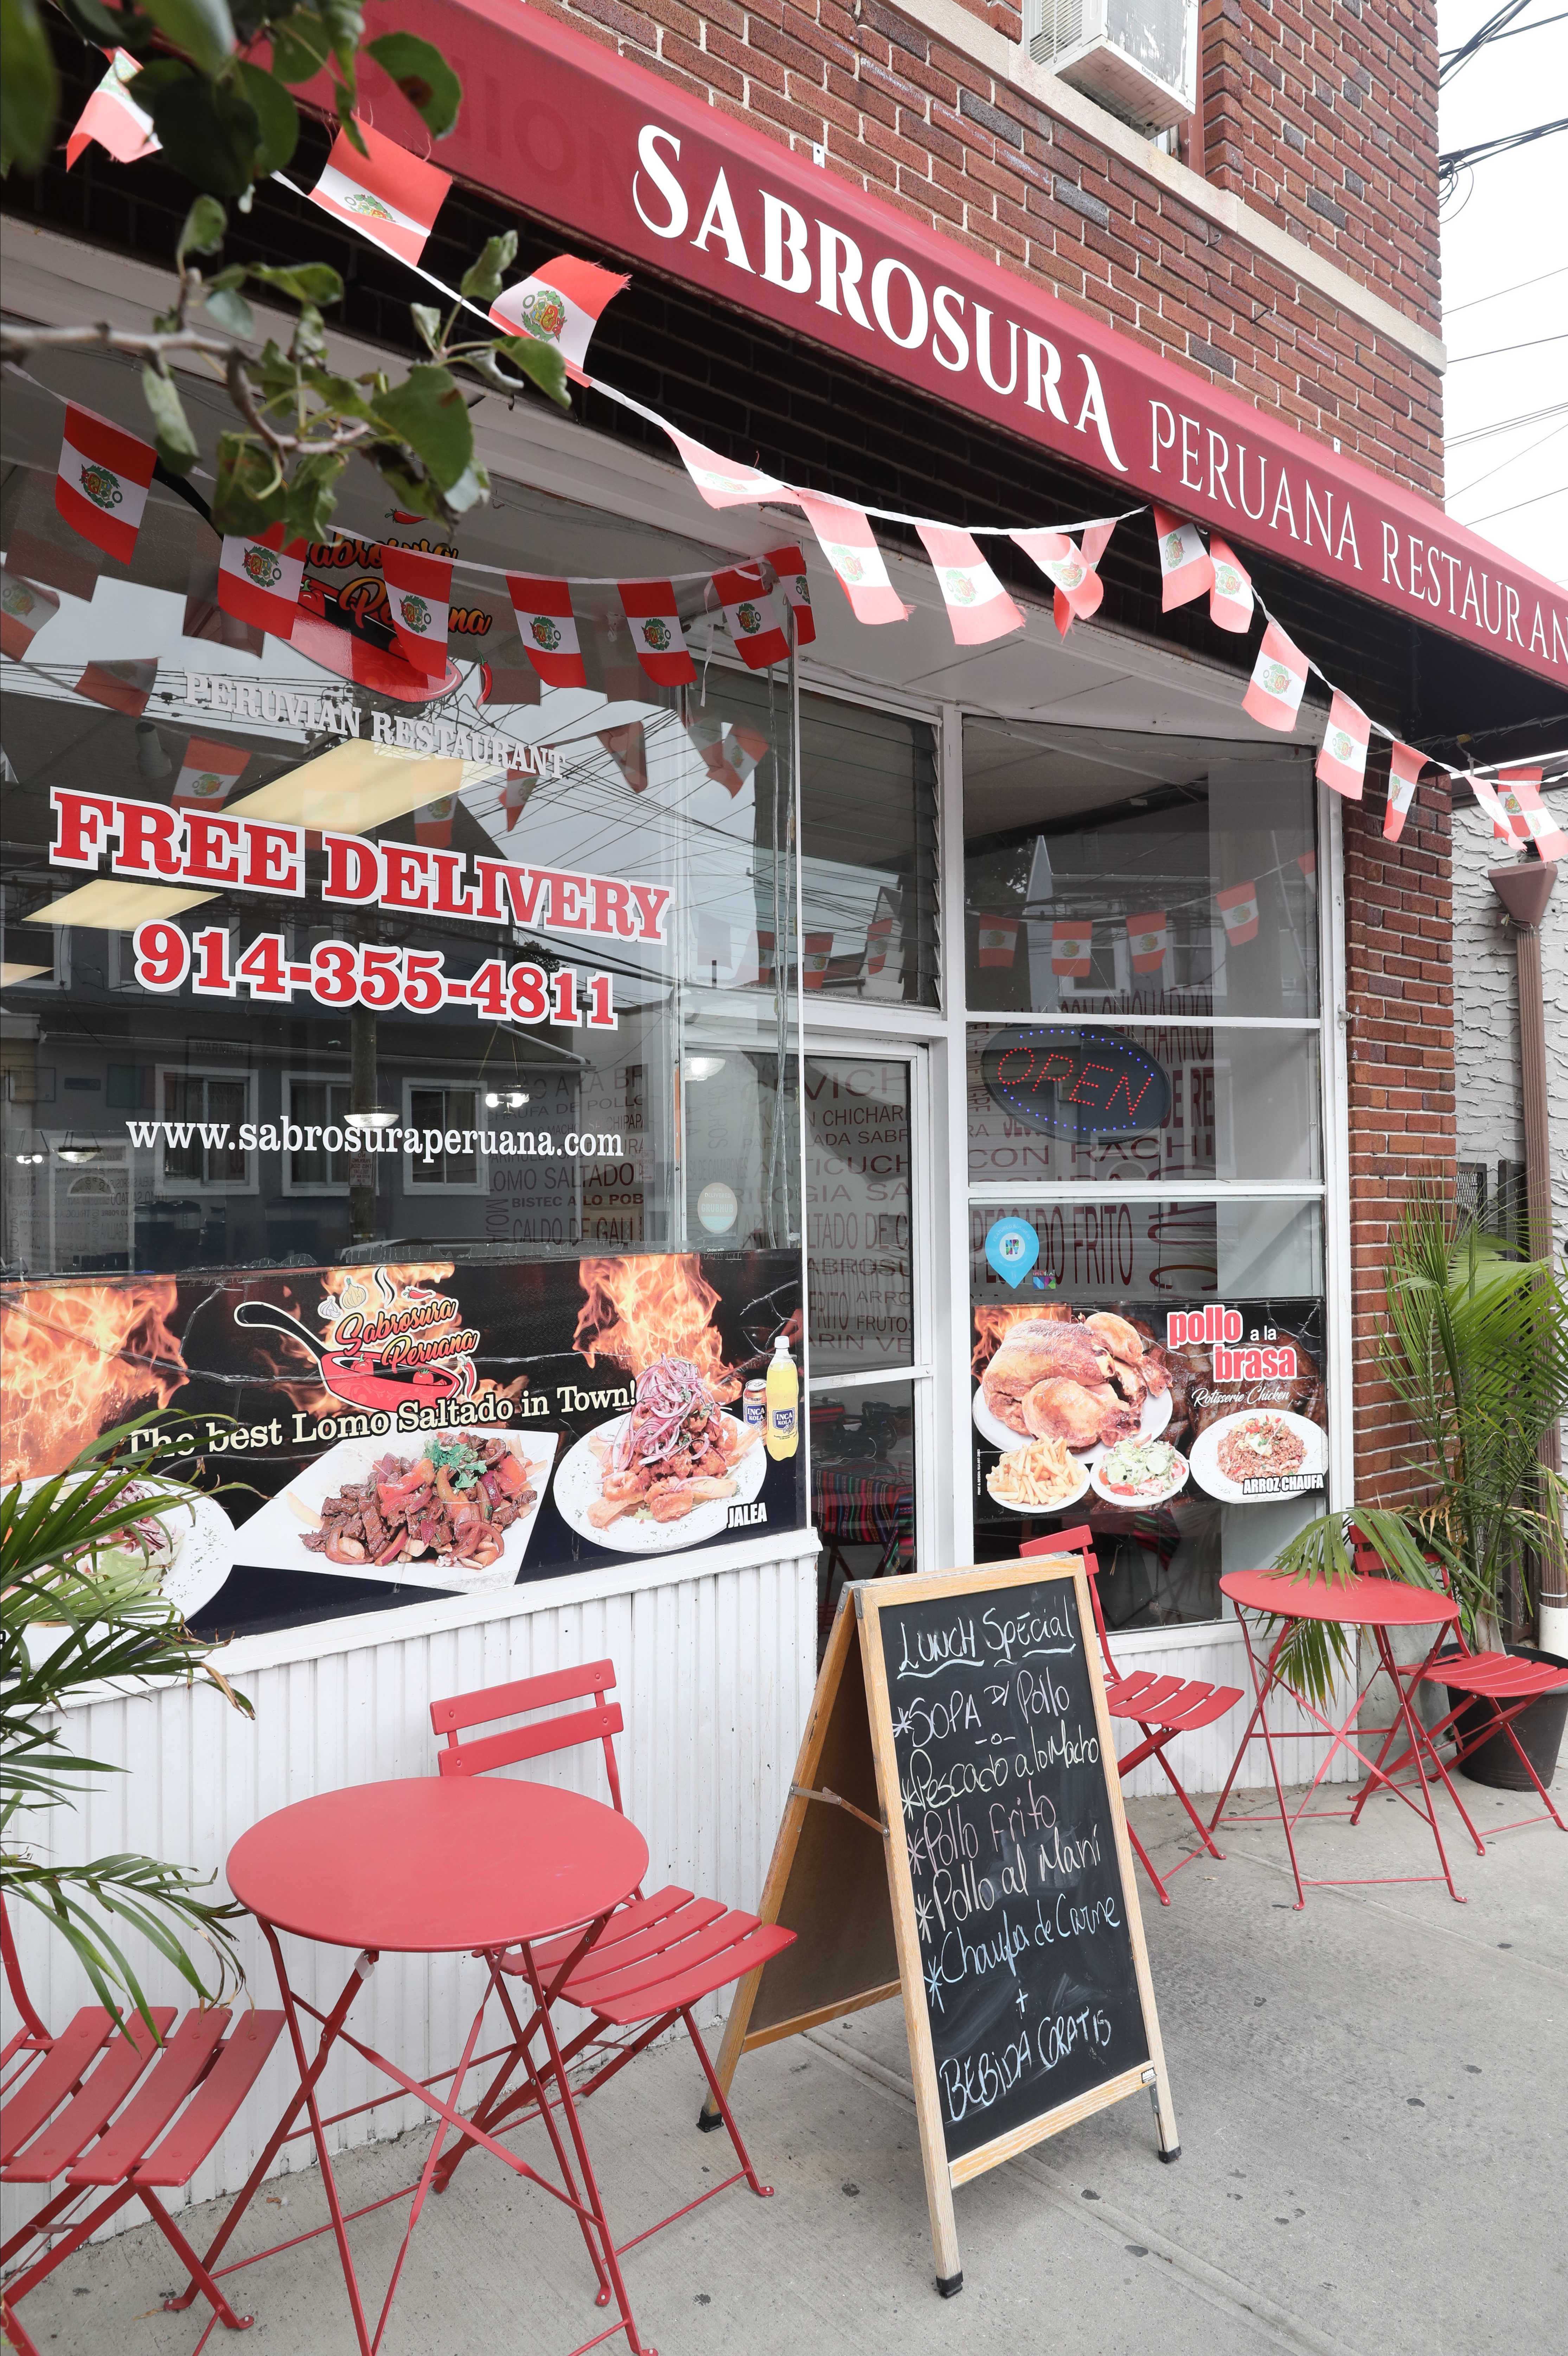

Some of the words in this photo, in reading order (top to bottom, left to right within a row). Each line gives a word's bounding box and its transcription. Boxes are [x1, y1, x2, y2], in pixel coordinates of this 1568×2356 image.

[1141, 65, 1160, 83] Danby
[633, 125, 1128, 471] SABROSURA
[1149, 401, 1363, 570] PERUANA
[184, 670, 361, 737] PERUVIAN
[371, 711, 566, 779] RESTAURANT
[50, 786, 305, 898] FREE
[322, 830, 676, 945] DELIVERY
[133, 919, 618, 1030] 914-355-4811
[998, 1047, 1152, 1115] OPEN
[126, 1115, 623, 1163] www.sabrosuraperuana.com
[486, 1168, 537, 1192] LOMO
[545, 1162, 633, 1189] SALTADO
[512, 1196, 562, 1208] BISTEC
[567, 1196, 576, 1206] A
[583, 1195, 602, 1206] LO
[701, 1203, 734, 1213] GRUBHUB
[1074, 1203, 1133, 1286] FRITO
[336, 1299, 456, 1357] Sabrosura
[381, 1331, 478, 1374] Peruana
[1167, 1304, 1243, 1349] pollo
[1250, 1329, 1259, 1341] a
[1264, 1326, 1277, 1341] la
[1213, 1343, 1297, 1383] brasa
[129, 1429, 196, 1458] The
[205, 1417, 283, 1452] best
[292, 1412, 389, 1444] Lomo
[398, 1394, 513, 1431] Saltado
[521, 1390, 550, 1417] in
[557, 1380, 637, 1412] Town!
[776, 1412, 793, 1420] INCA
[1191, 1387, 1245, 1407] Rotisserie
[1247, 1385, 1291, 1405] Chicken
[1243, 1477, 1281, 1495] ARROZ
[1280, 1473, 1324, 1494] CHAUFA
[728, 1502, 768, 1529] JALEA
[899, 1617, 976, 1671] LUNCH
[909, 1690, 982, 1748] SOPA
[1017, 1666, 1070, 1724] Pollo
[910, 1748, 1009, 1811] Pescado
[1015, 1753, 1034, 1777] a
[924, 1803, 978, 1877] Pollo
[933, 1860, 995, 1932] Pollo
[1002, 1843, 1029, 1896] al
[941, 1909, 1030, 1983] Chaufa
[1035, 1899, 1054, 1946] de
[1056, 1893, 1120, 1937] Carne
[1037, 2006, 1112, 2068] GRATIS
